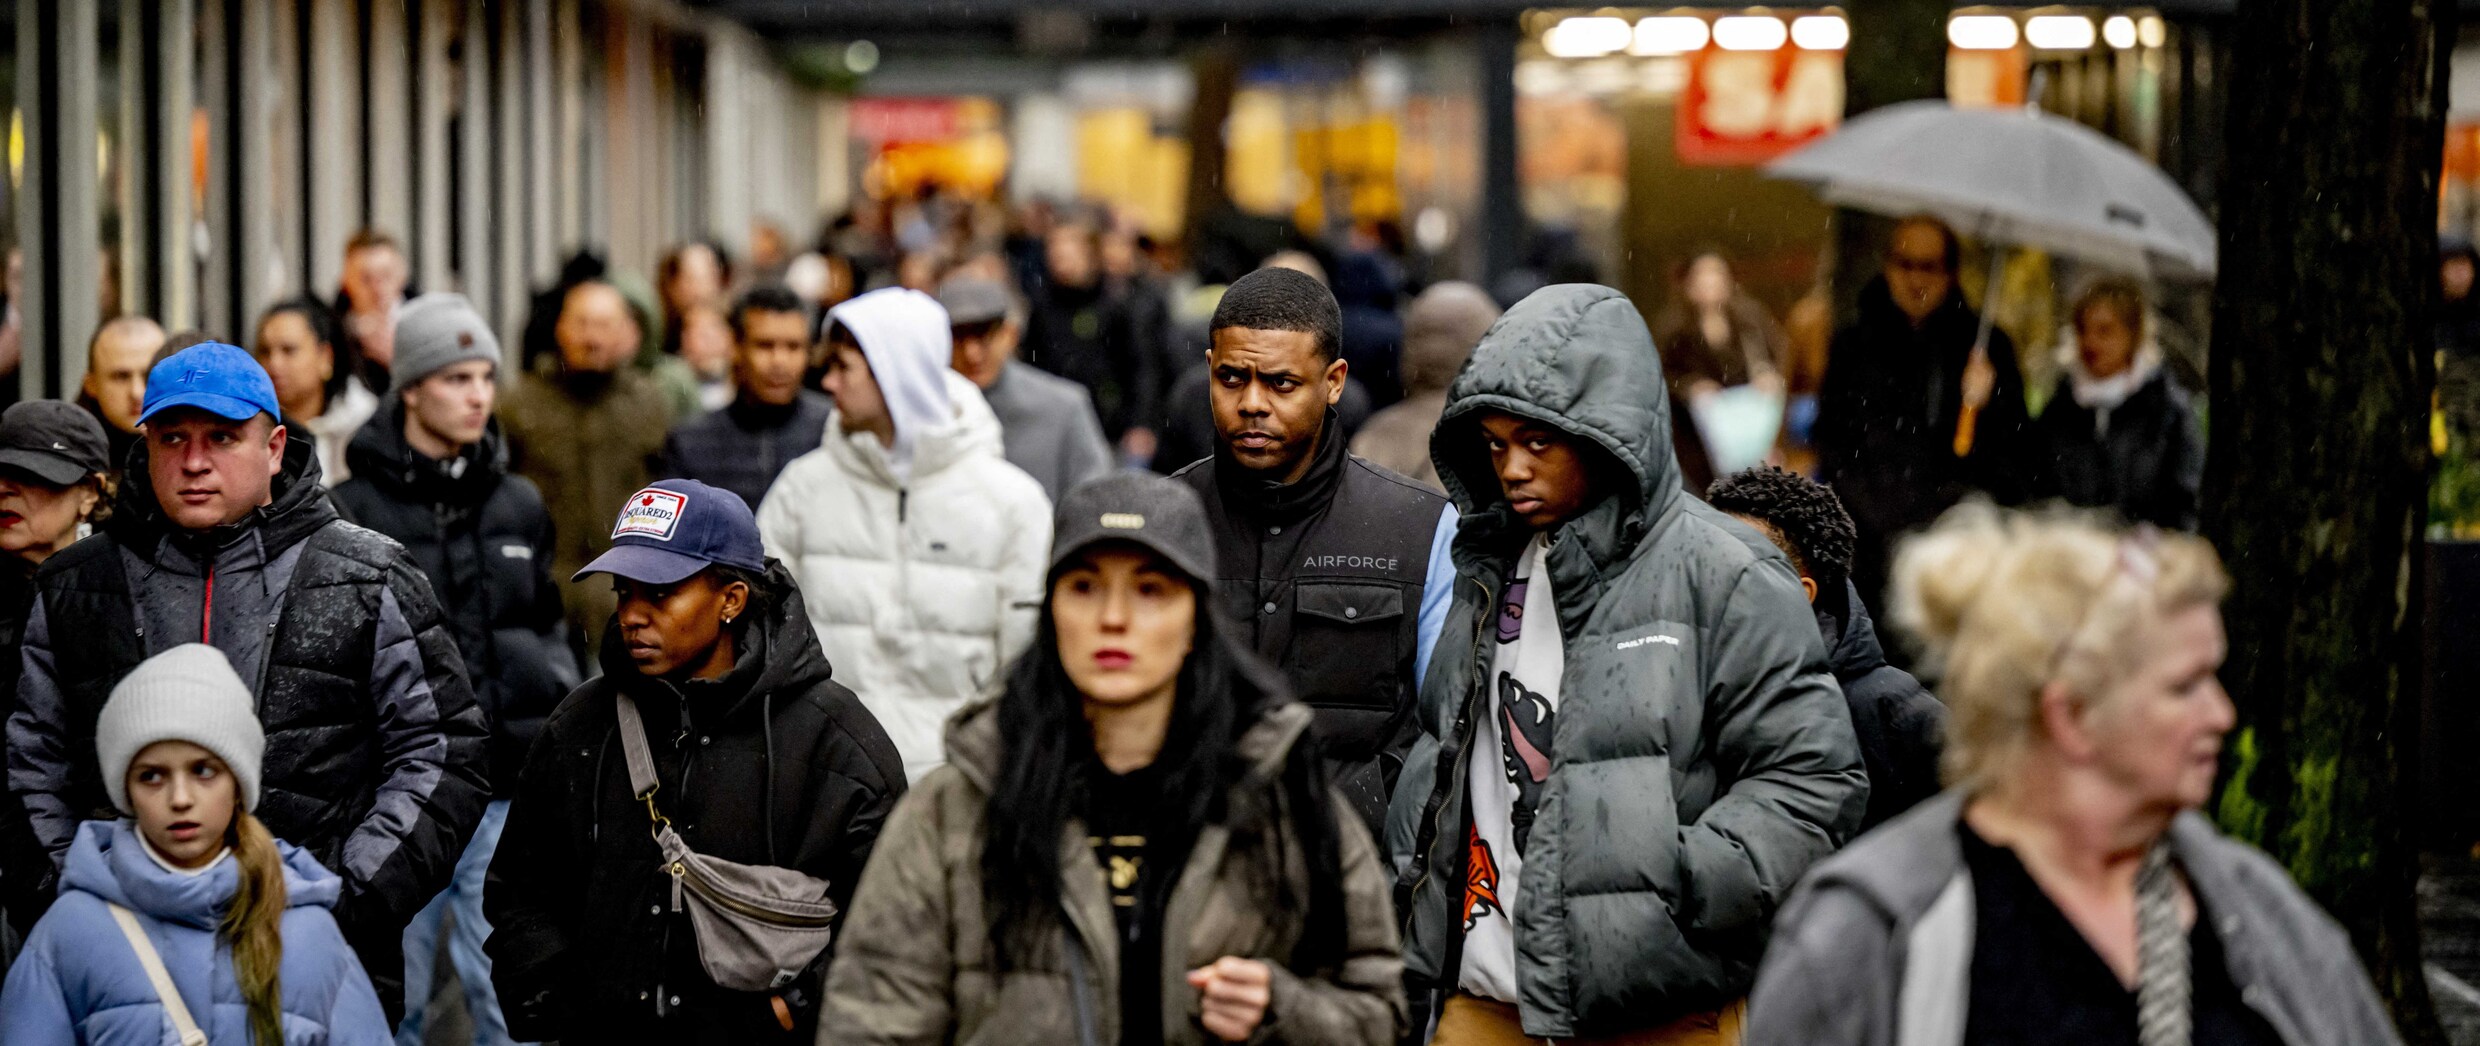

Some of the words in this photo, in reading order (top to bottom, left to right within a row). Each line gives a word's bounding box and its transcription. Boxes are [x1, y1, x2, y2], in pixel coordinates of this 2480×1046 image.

[1303, 555, 1399, 571] AIRFORCE
[1616, 638, 1645, 650] DAILY
[1645, 634, 1679, 646] PAPER
